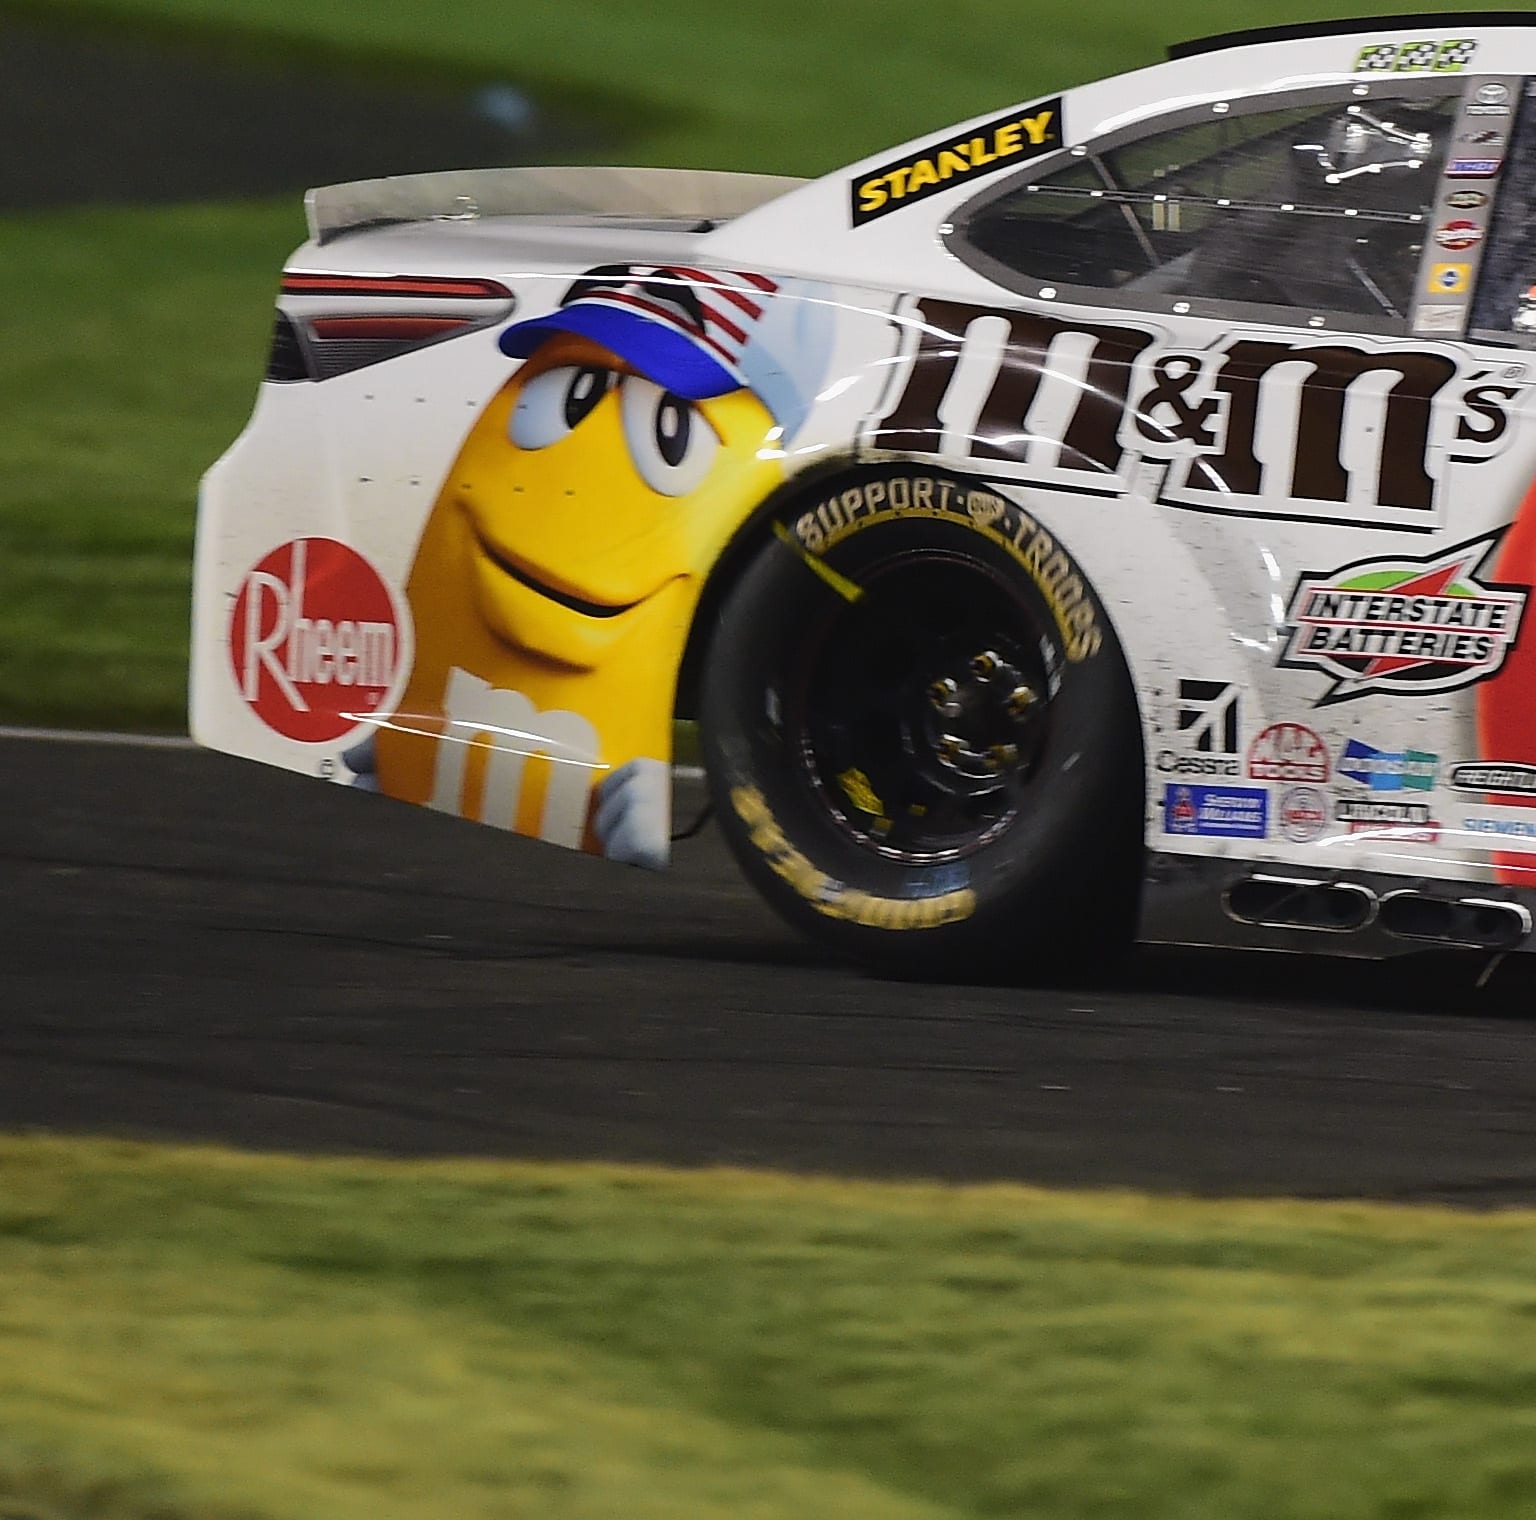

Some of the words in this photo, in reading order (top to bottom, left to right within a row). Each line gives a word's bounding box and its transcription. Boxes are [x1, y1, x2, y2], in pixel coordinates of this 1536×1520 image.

[858, 111, 1054, 212] STANLEY
[795, 478, 957, 551] SUPPORT
[1014, 511, 1103, 664] TROOPS
[243, 540, 395, 711] Rheem
[1308, 592, 1507, 629] INTERSTATE
[1309, 627, 1491, 660] BATTERIES
[1156, 749, 1240, 775] Cessna
